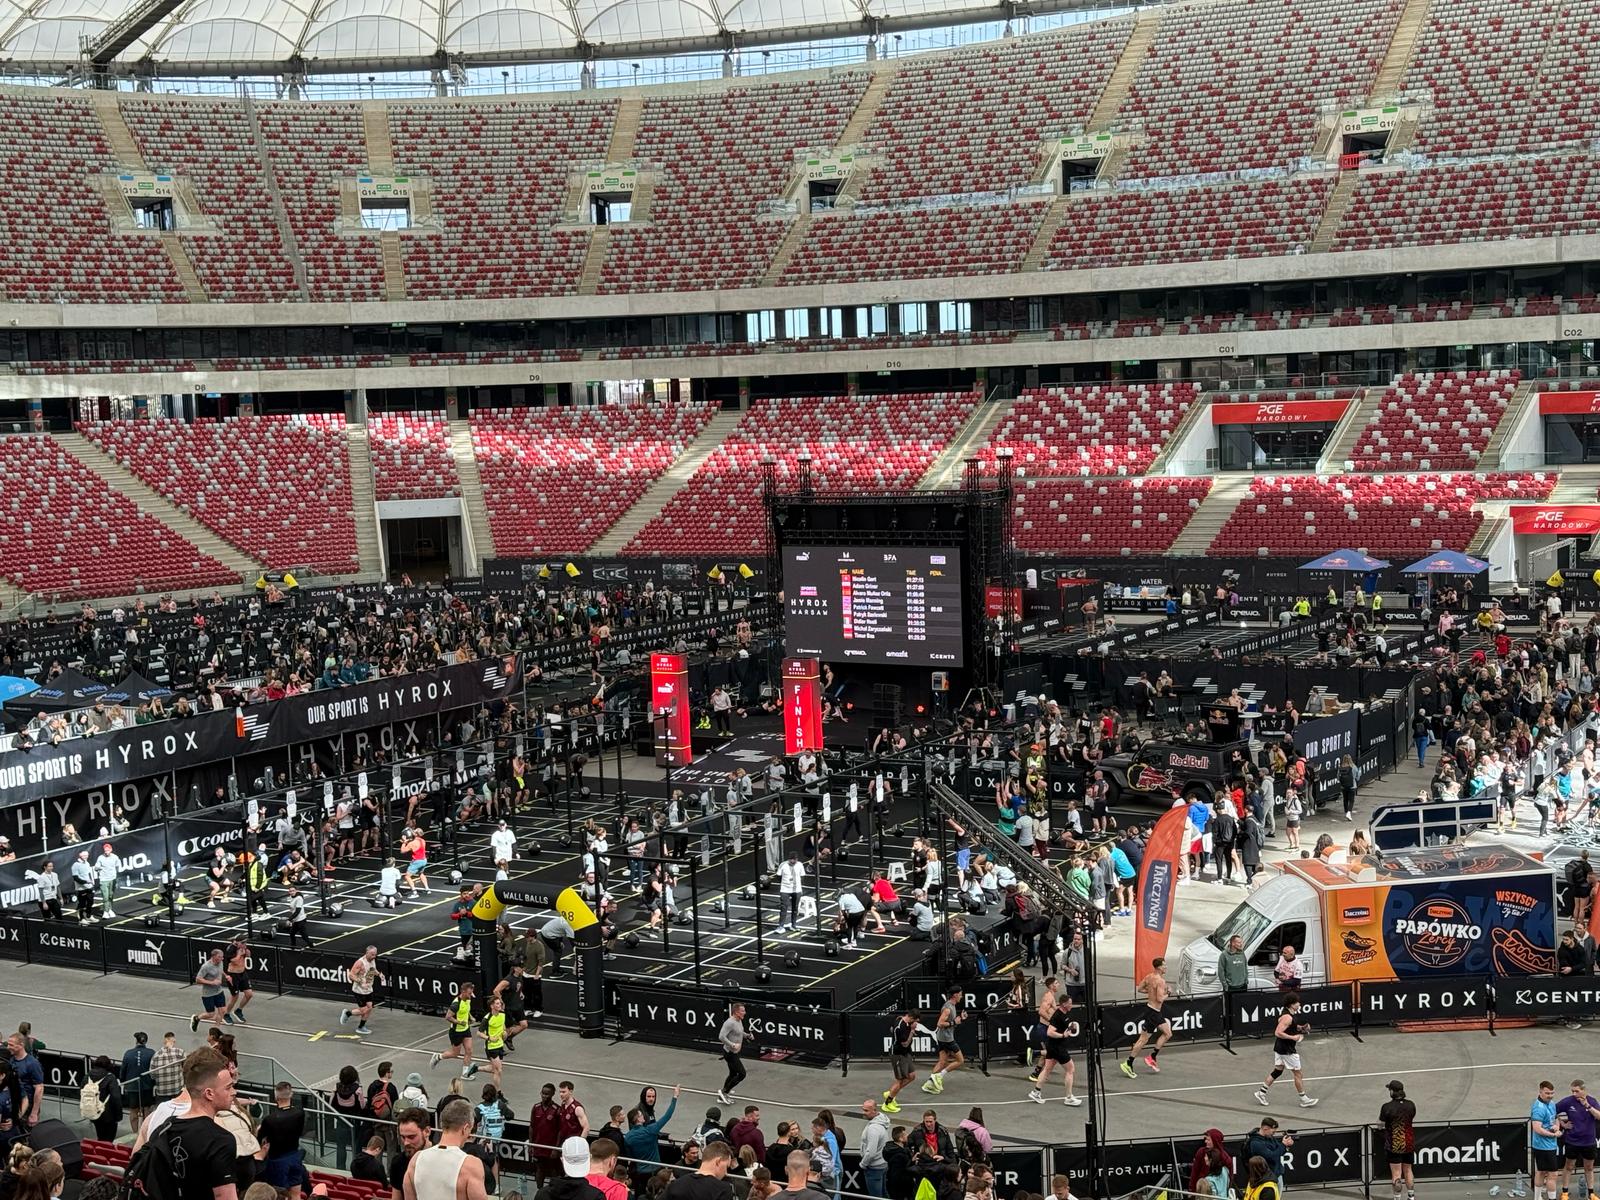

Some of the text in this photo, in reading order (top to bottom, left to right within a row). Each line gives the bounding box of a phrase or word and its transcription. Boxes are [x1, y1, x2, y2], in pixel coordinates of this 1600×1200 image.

[1563, 329, 1583, 337] C02
[1218, 345, 1235, 353] C01
[1255, 413, 1308, 422] NARODOWY
[1257, 404, 1285, 415] PGE
[1535, 511, 1565, 522] PGE
[790, 599, 828, 607] HYROX
[544, 644, 571, 656] HYROX
[613, 632, 634, 642] YROX
[637, 628, 662, 638] HYROX
[667, 622, 691, 632] HYROX
[694, 617, 718, 626] HYROX
[721, 612, 743, 622] HYROX
[30, 648, 65, 660] HYROX
[1222, 648, 1239, 659] YROX
[307, 679, 453, 725] OUR SPORT IS HYROX
[794, 684, 804, 748] FINISH
[1305, 730, 1351, 760] OUR SPORT IS
[0, 730, 199, 790] OUR SPORT IS HYROX
[669, 775, 726, 784] HYRO
[16, 775, 172, 837] HYROX
[503, 891, 549, 905] WALL BALLS
[1147, 863, 1168, 929] TARCZYŃSKI
[1495, 890, 1538, 909] WSZYSCY
[1395, 918, 1482, 940] PARÓWKO
[51, 935, 91, 951] CENTR
[127, 949, 159, 965] PUMA
[398, 975, 460, 996] HYRO
[577, 979, 586, 1008] BALLS
[1371, 989, 1477, 1011] HYROX
[627, 1002, 717, 1028] HYROX
[764, 1020, 825, 1041] CENTR
[1108, 1166, 1132, 1177] FOR
